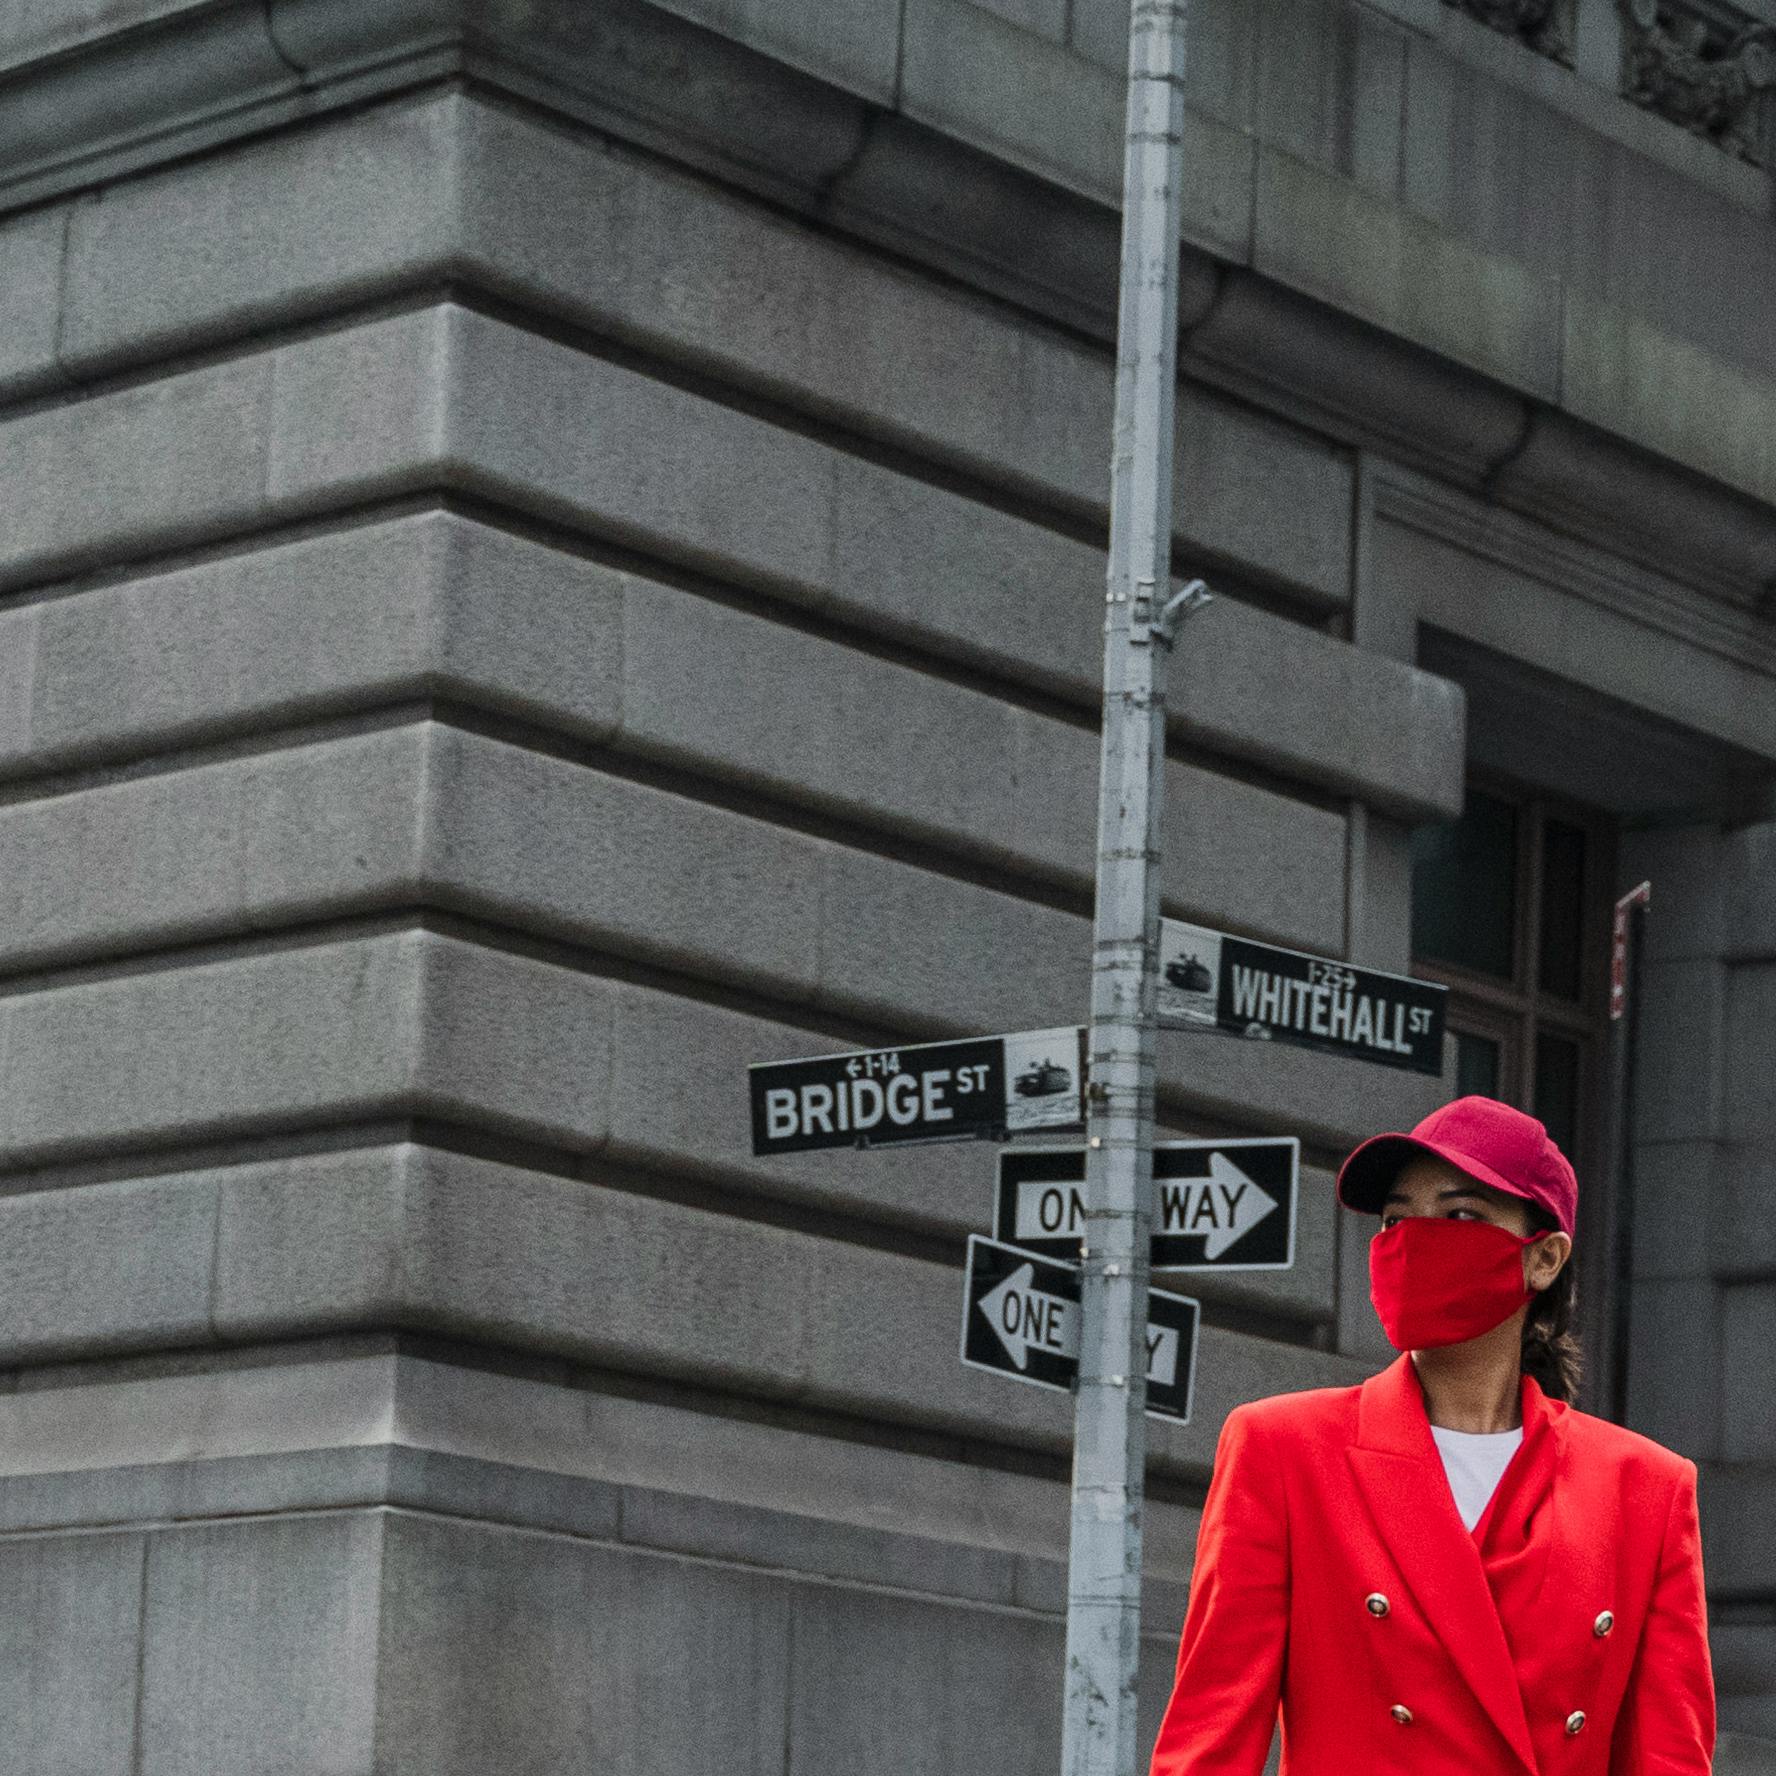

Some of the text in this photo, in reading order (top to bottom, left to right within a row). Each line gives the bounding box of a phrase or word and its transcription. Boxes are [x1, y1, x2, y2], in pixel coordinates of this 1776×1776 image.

[1232, 964, 1434, 1056] WHITEHALL ST
[865, 1052, 902, 1078] 1-14
[765, 1064, 991, 1140] BRIDGE ST
[1039, 1183, 1248, 1232] ON WAY
[1002, 1289, 1064, 1349] ONE
